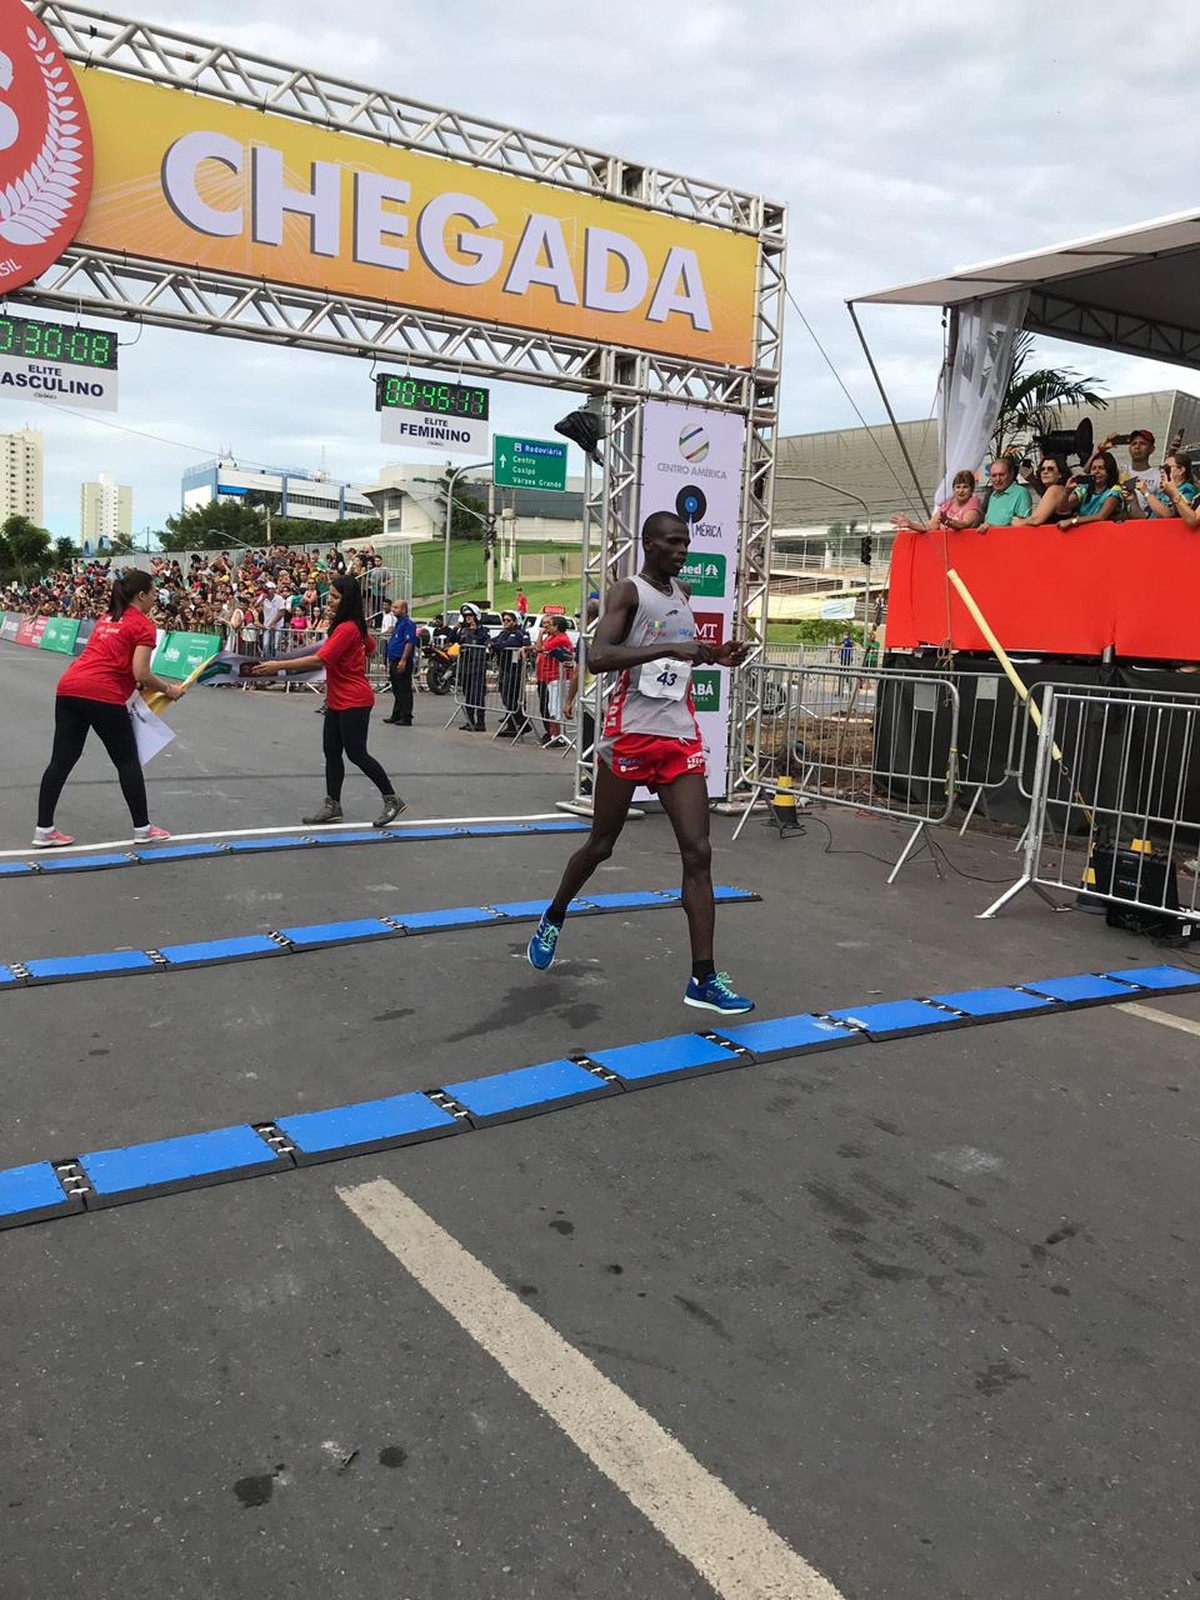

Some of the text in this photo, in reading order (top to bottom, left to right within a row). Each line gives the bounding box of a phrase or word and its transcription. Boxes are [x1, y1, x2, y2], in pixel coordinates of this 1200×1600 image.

[161, 130, 713, 332] CHEGADA
[0, 258, 22, 277] SIL
[28, 364, 62, 377] ELITE
[424, 417, 448, 427] ELITE
[400, 423, 471, 443] FEMININO
[512, 455, 536, 465] Centro
[657, 462, 727, 479] CENTRO AMÉRICA
[538, 480, 562, 488] Grande
[695, 522, 723, 538] MÉRICA
[656, 671, 678, 687] 43
[690, 680, 714, 696] ABÁ
